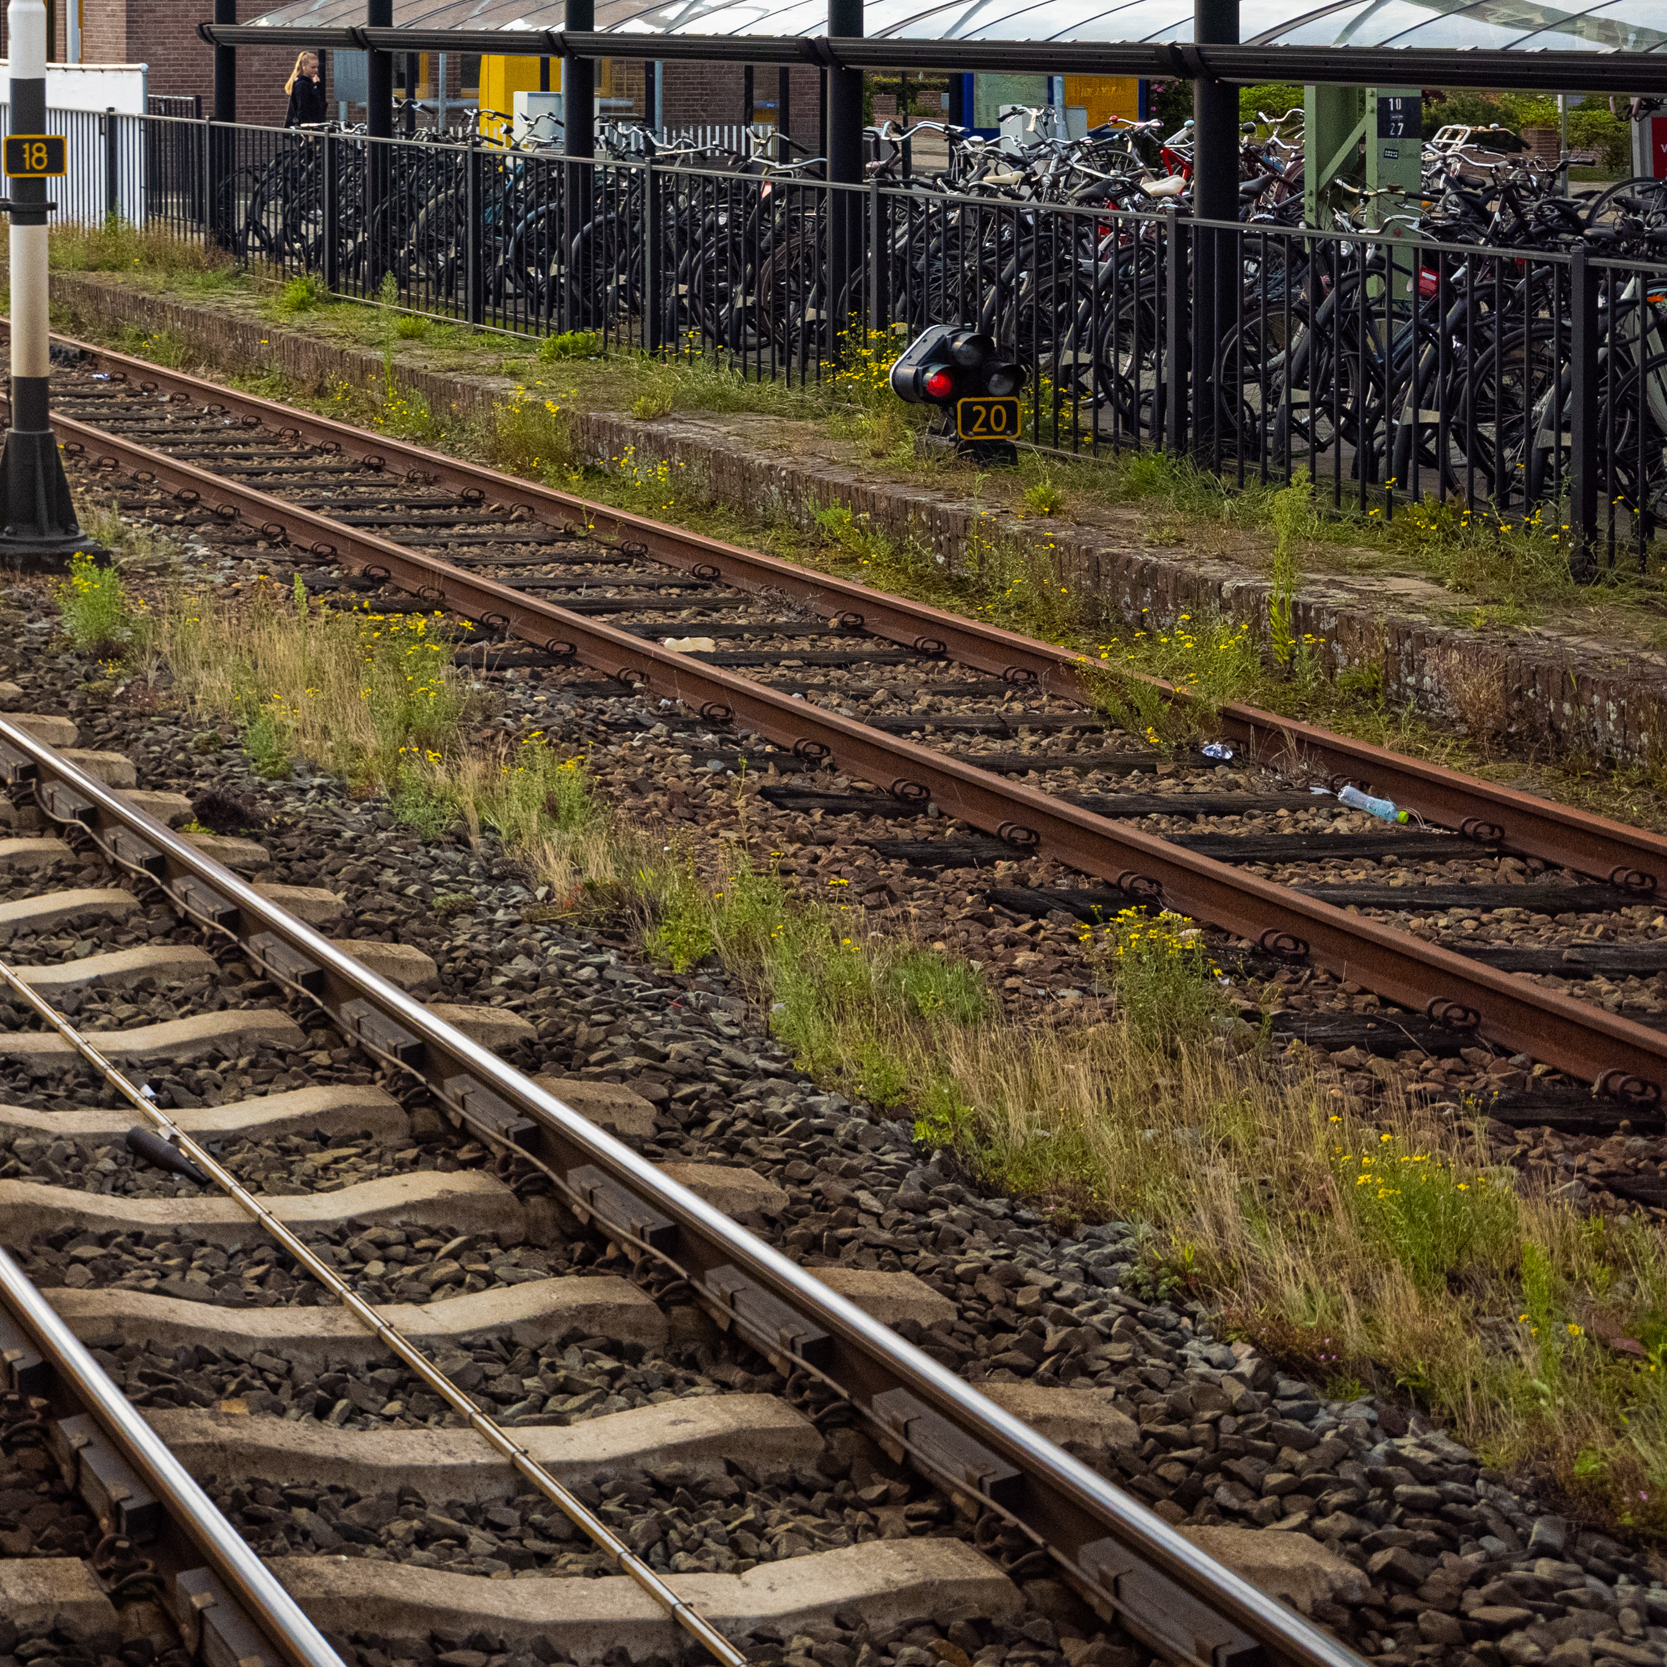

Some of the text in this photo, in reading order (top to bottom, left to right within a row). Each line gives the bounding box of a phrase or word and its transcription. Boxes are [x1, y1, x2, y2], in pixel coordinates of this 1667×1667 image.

[1389, 122, 1404, 136] 27
[23, 142, 48, 170] 18
[972, 405, 1007, 432] 20
